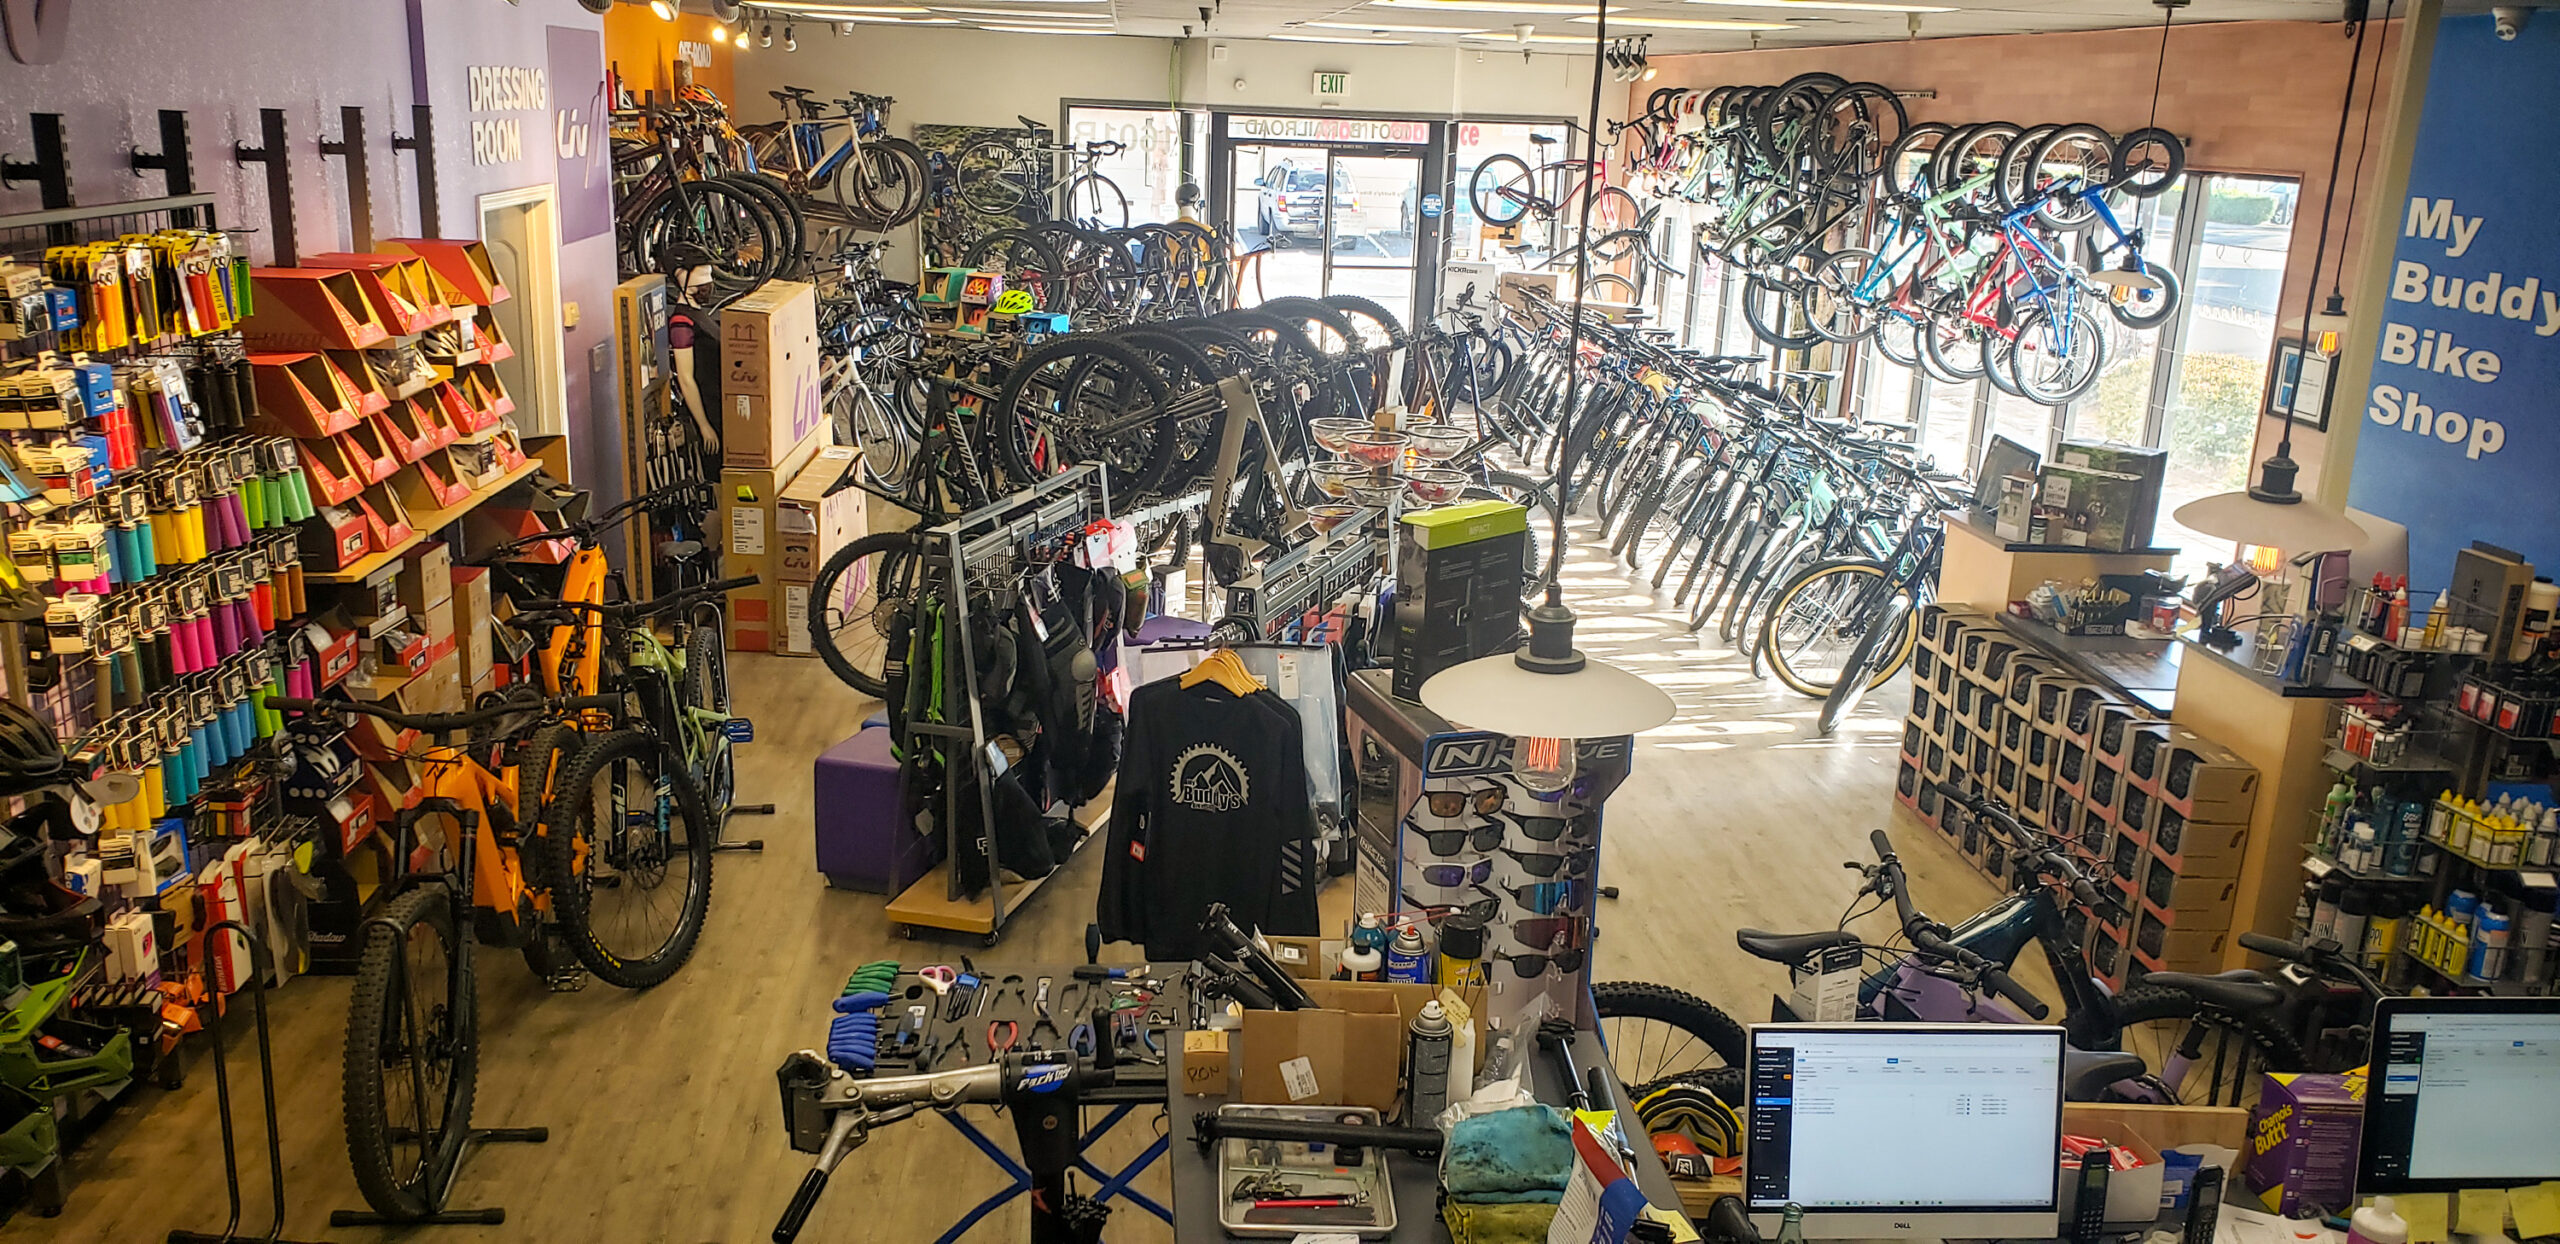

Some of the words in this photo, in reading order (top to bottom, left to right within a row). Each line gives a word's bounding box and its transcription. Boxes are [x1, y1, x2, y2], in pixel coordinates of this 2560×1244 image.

[468, 65, 546, 112] DRESSING
[1320, 73, 1347, 95] EXIT
[472, 118, 522, 166] ROOM
[557, 108, 589, 160] Liv
[2405, 197, 2484, 257] My
[2391, 260, 2560, 337] Buddy
[730, 370, 758, 383] Liv
[2380, 322, 2502, 384] Bike
[2368, 384, 2505, 460] Shop
[945, 411, 981, 487] SPECIALIZED
[1216, 477, 1232, 537] NORCO
[1468, 523, 1491, 537] IMPACT
[783, 556, 811, 568] Liv
[1184, 784, 1241, 812] Buddy's
[1187, 1064, 1222, 1083] RON
[2259, 1104, 2293, 1134] Chamois
[1894, 1222, 1911, 1230] DELL
